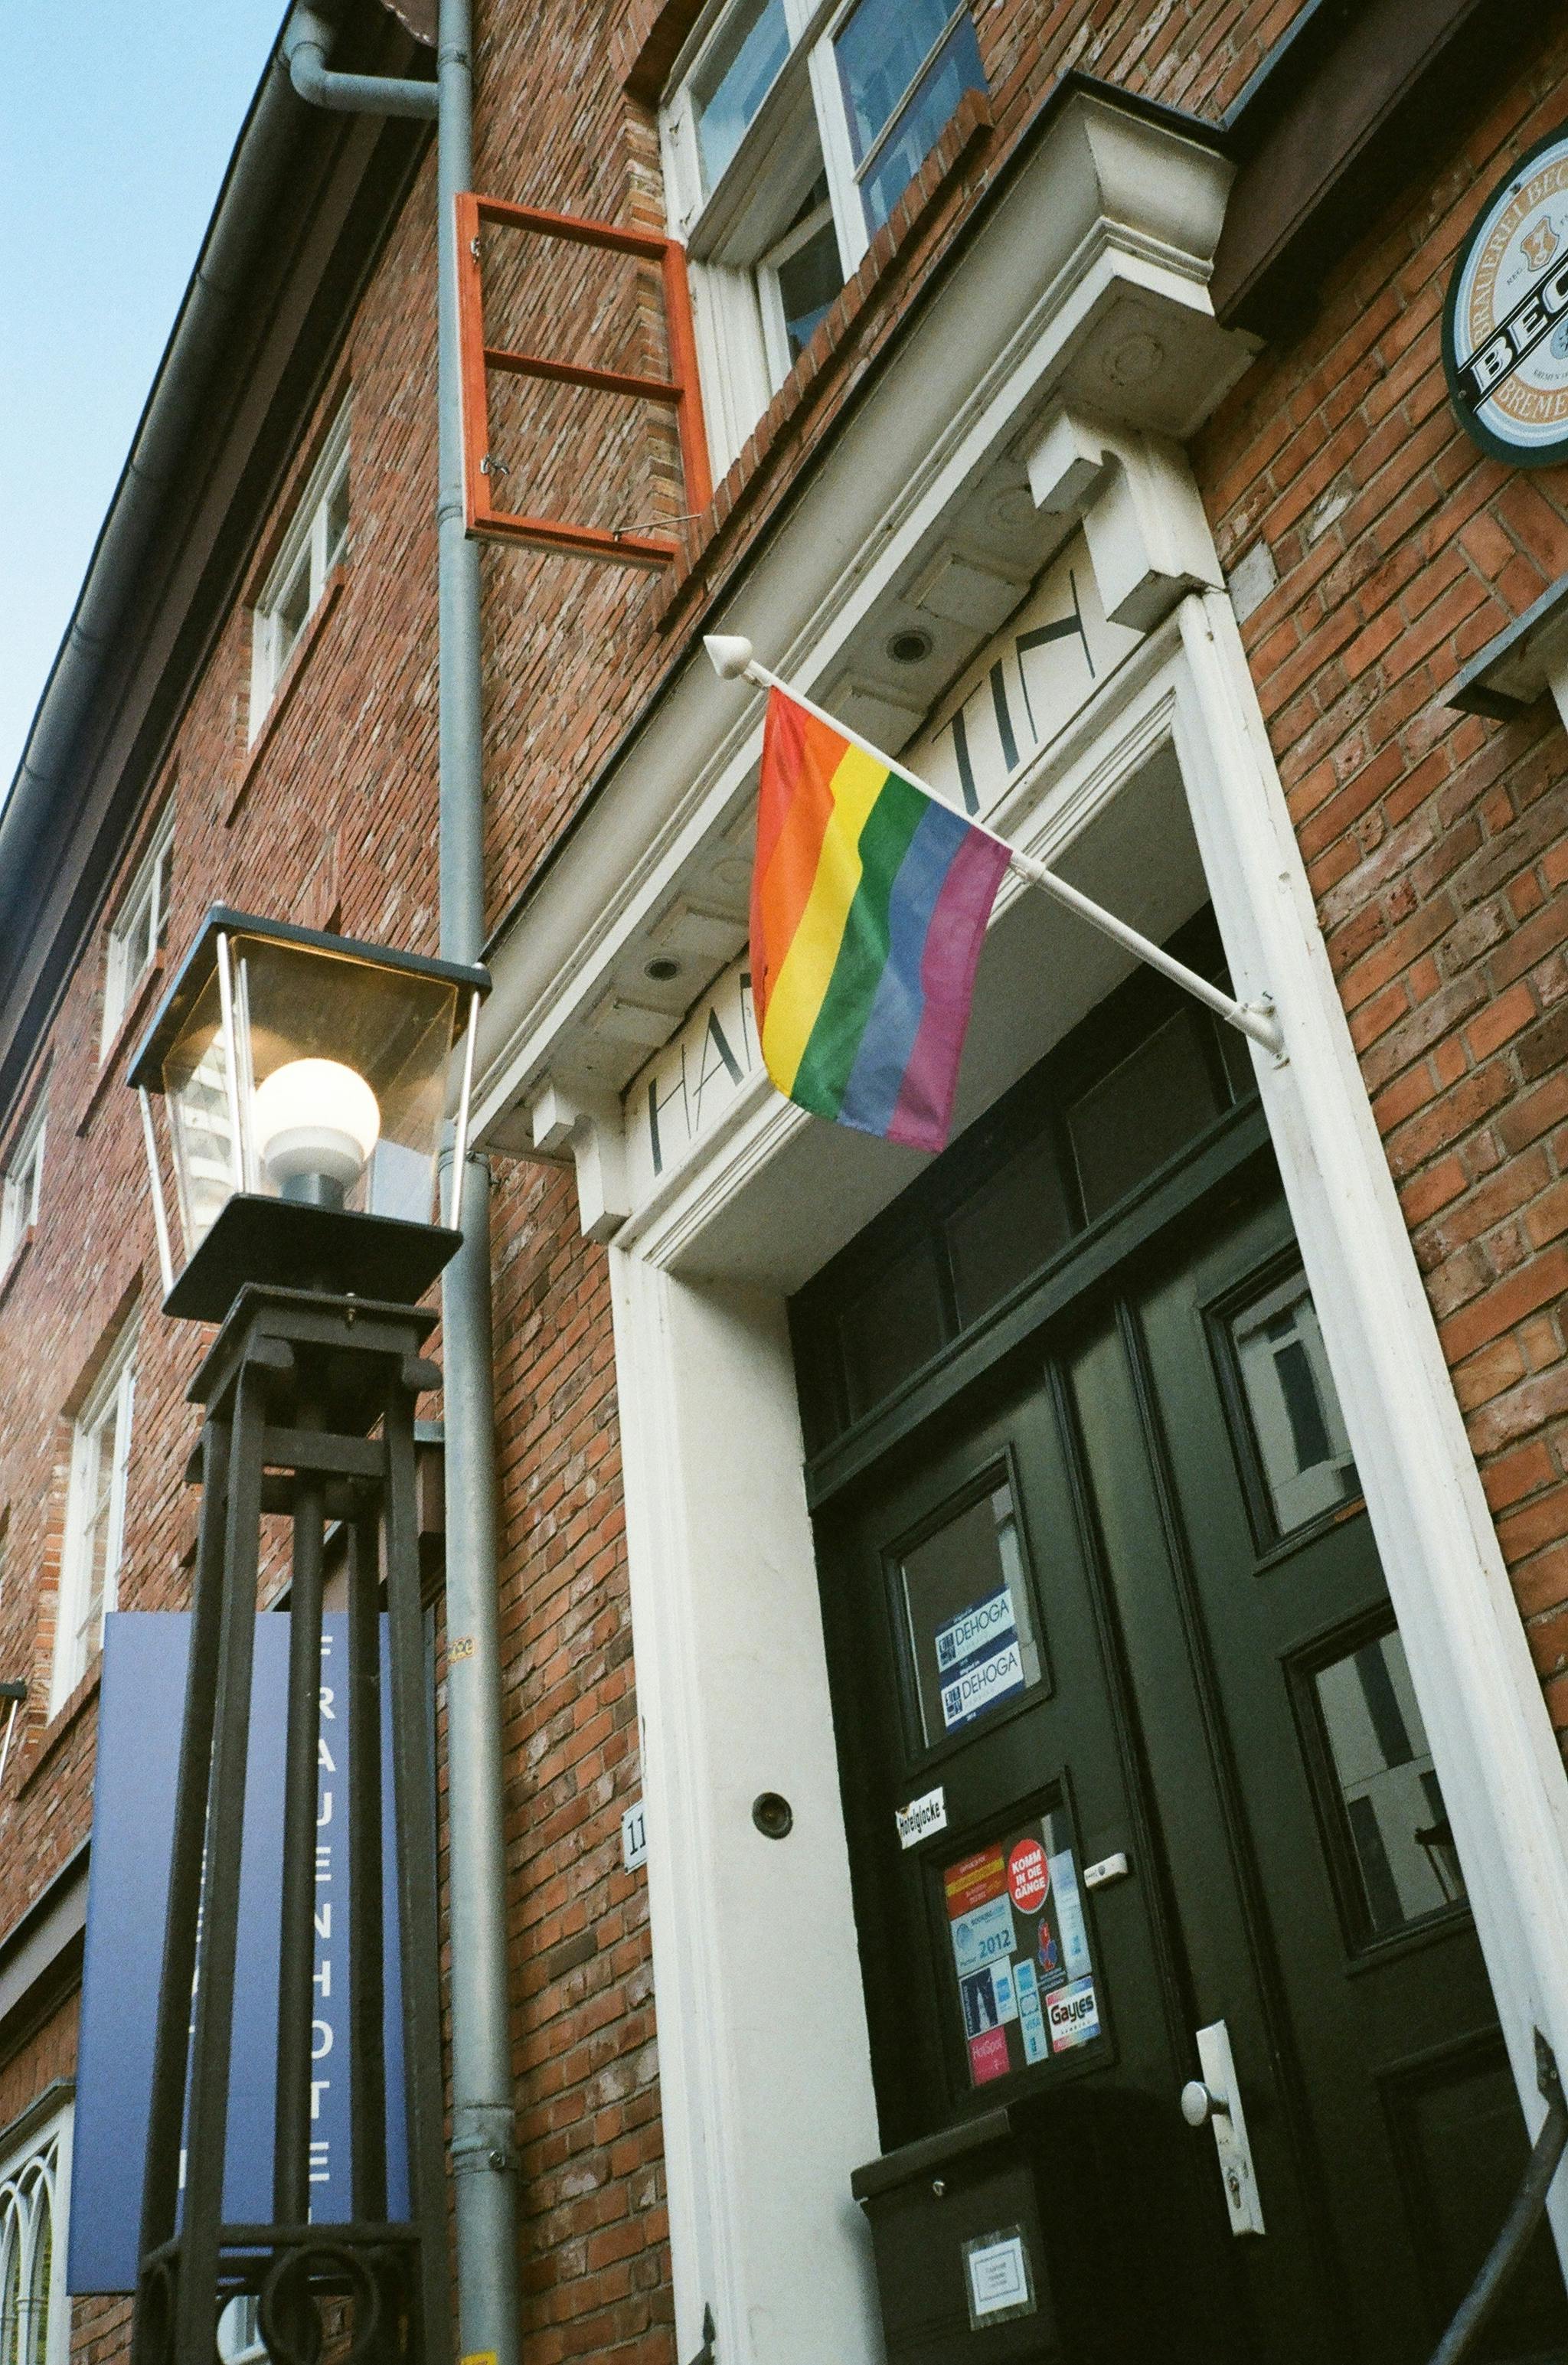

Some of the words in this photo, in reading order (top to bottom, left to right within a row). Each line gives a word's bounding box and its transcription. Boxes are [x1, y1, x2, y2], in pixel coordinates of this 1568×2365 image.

[1473, 203, 1524, 343] BRAUEREI
[955, 1599, 1009, 1647] DEHOGA
[962, 1652, 1018, 1700] DEHOGA
[628, 1812, 646, 1856] 11
[899, 1799, 941, 1836] Hotelglocke
[1011, 1849, 1042, 1874] KOMM
[1016, 1873, 1026, 1885] IN
[1027, 1864, 1042, 1880] DIE
[978, 1929, 1011, 1958] 2012
